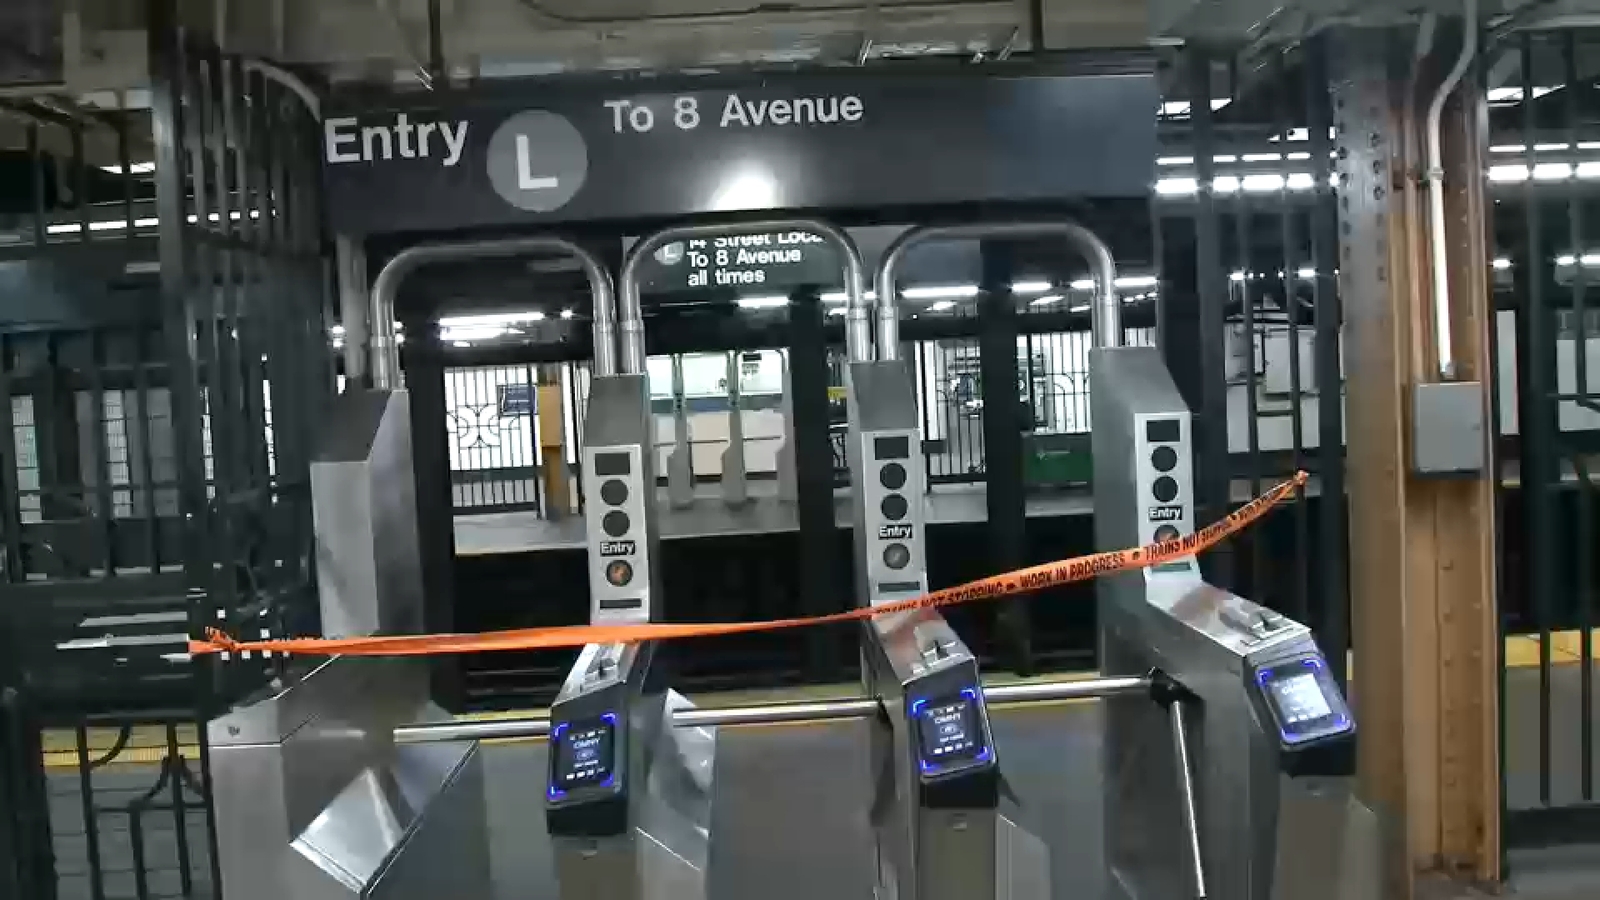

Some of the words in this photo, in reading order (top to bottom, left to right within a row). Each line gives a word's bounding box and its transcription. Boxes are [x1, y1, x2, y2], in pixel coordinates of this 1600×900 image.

[604, 99, 654, 134] To
[674, 96, 700, 130] 8
[719, 93, 864, 127] Avenue
[324, 112, 469, 167] Entry
[515, 134, 559, 189] L
[686, 250, 709, 268] To
[715, 249, 729, 266] 8
[736, 248, 801, 266] Avenue
[688, 270, 708, 286] all
[715, 267, 765, 285] times
[1149, 507, 1181, 521] Entry
[879, 525, 911, 539] Entry
[600, 541, 635, 556] Entry
[1020, 569, 1052, 588] WORK
[1055, 564, 1067, 581] IN
[1069, 552, 1126, 579] PROGRESS
